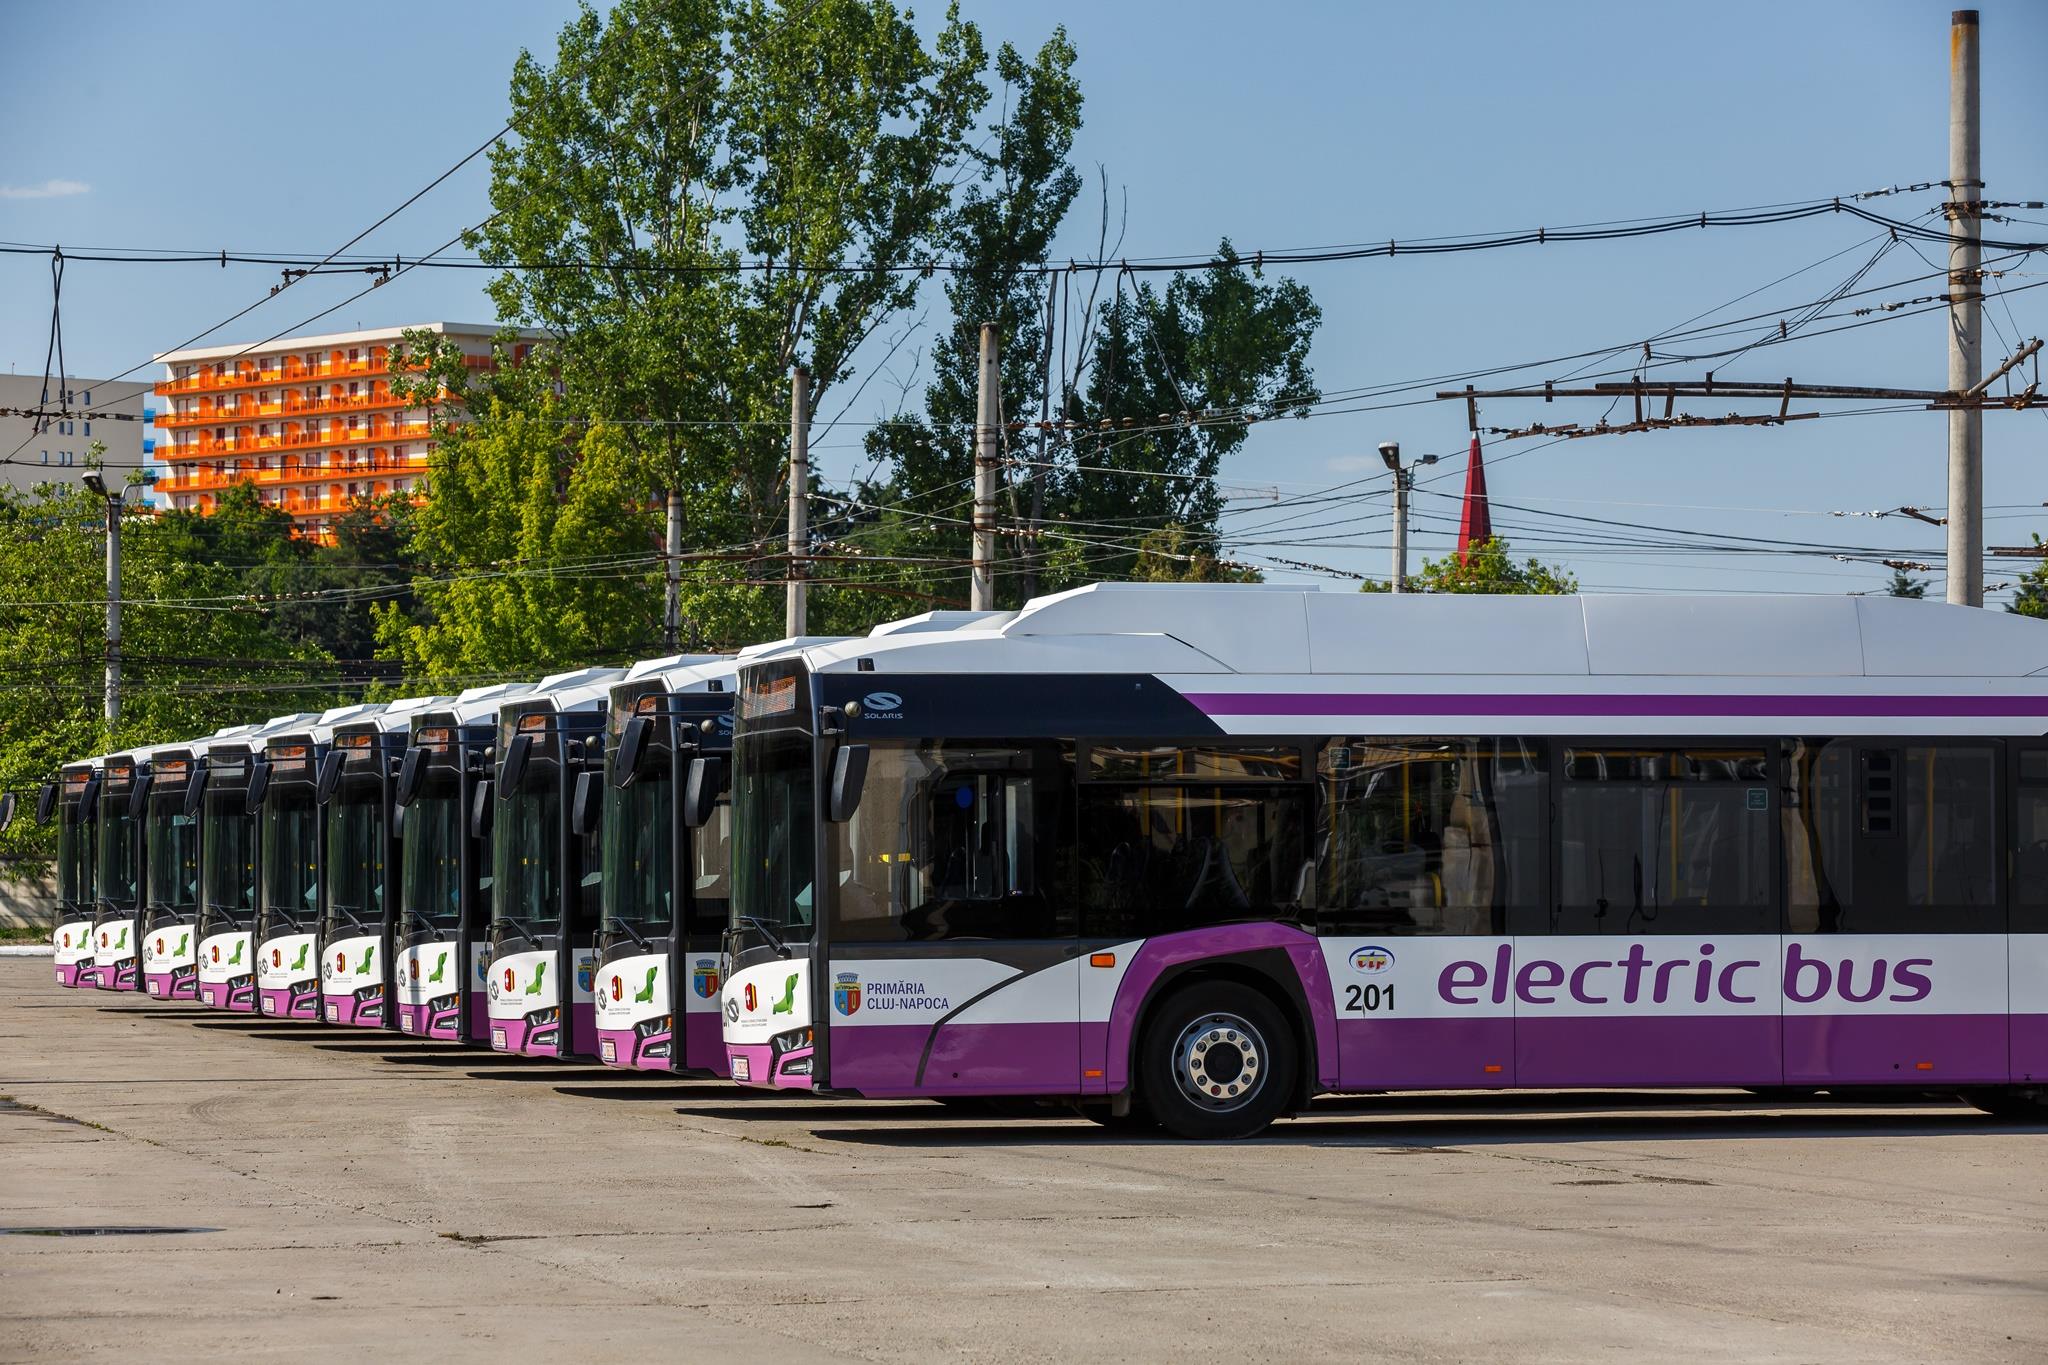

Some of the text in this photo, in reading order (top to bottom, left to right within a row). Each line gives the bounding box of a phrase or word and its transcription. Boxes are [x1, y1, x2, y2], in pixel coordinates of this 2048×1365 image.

[865, 712, 905, 720] SOLARIS
[1438, 943, 1933, 1005] electric bus
[867, 980, 926, 995] PRIMĂRIA
[867, 997, 949, 1010] CLUJ-NAPOCA
[1345, 983, 1394, 1011] 201
